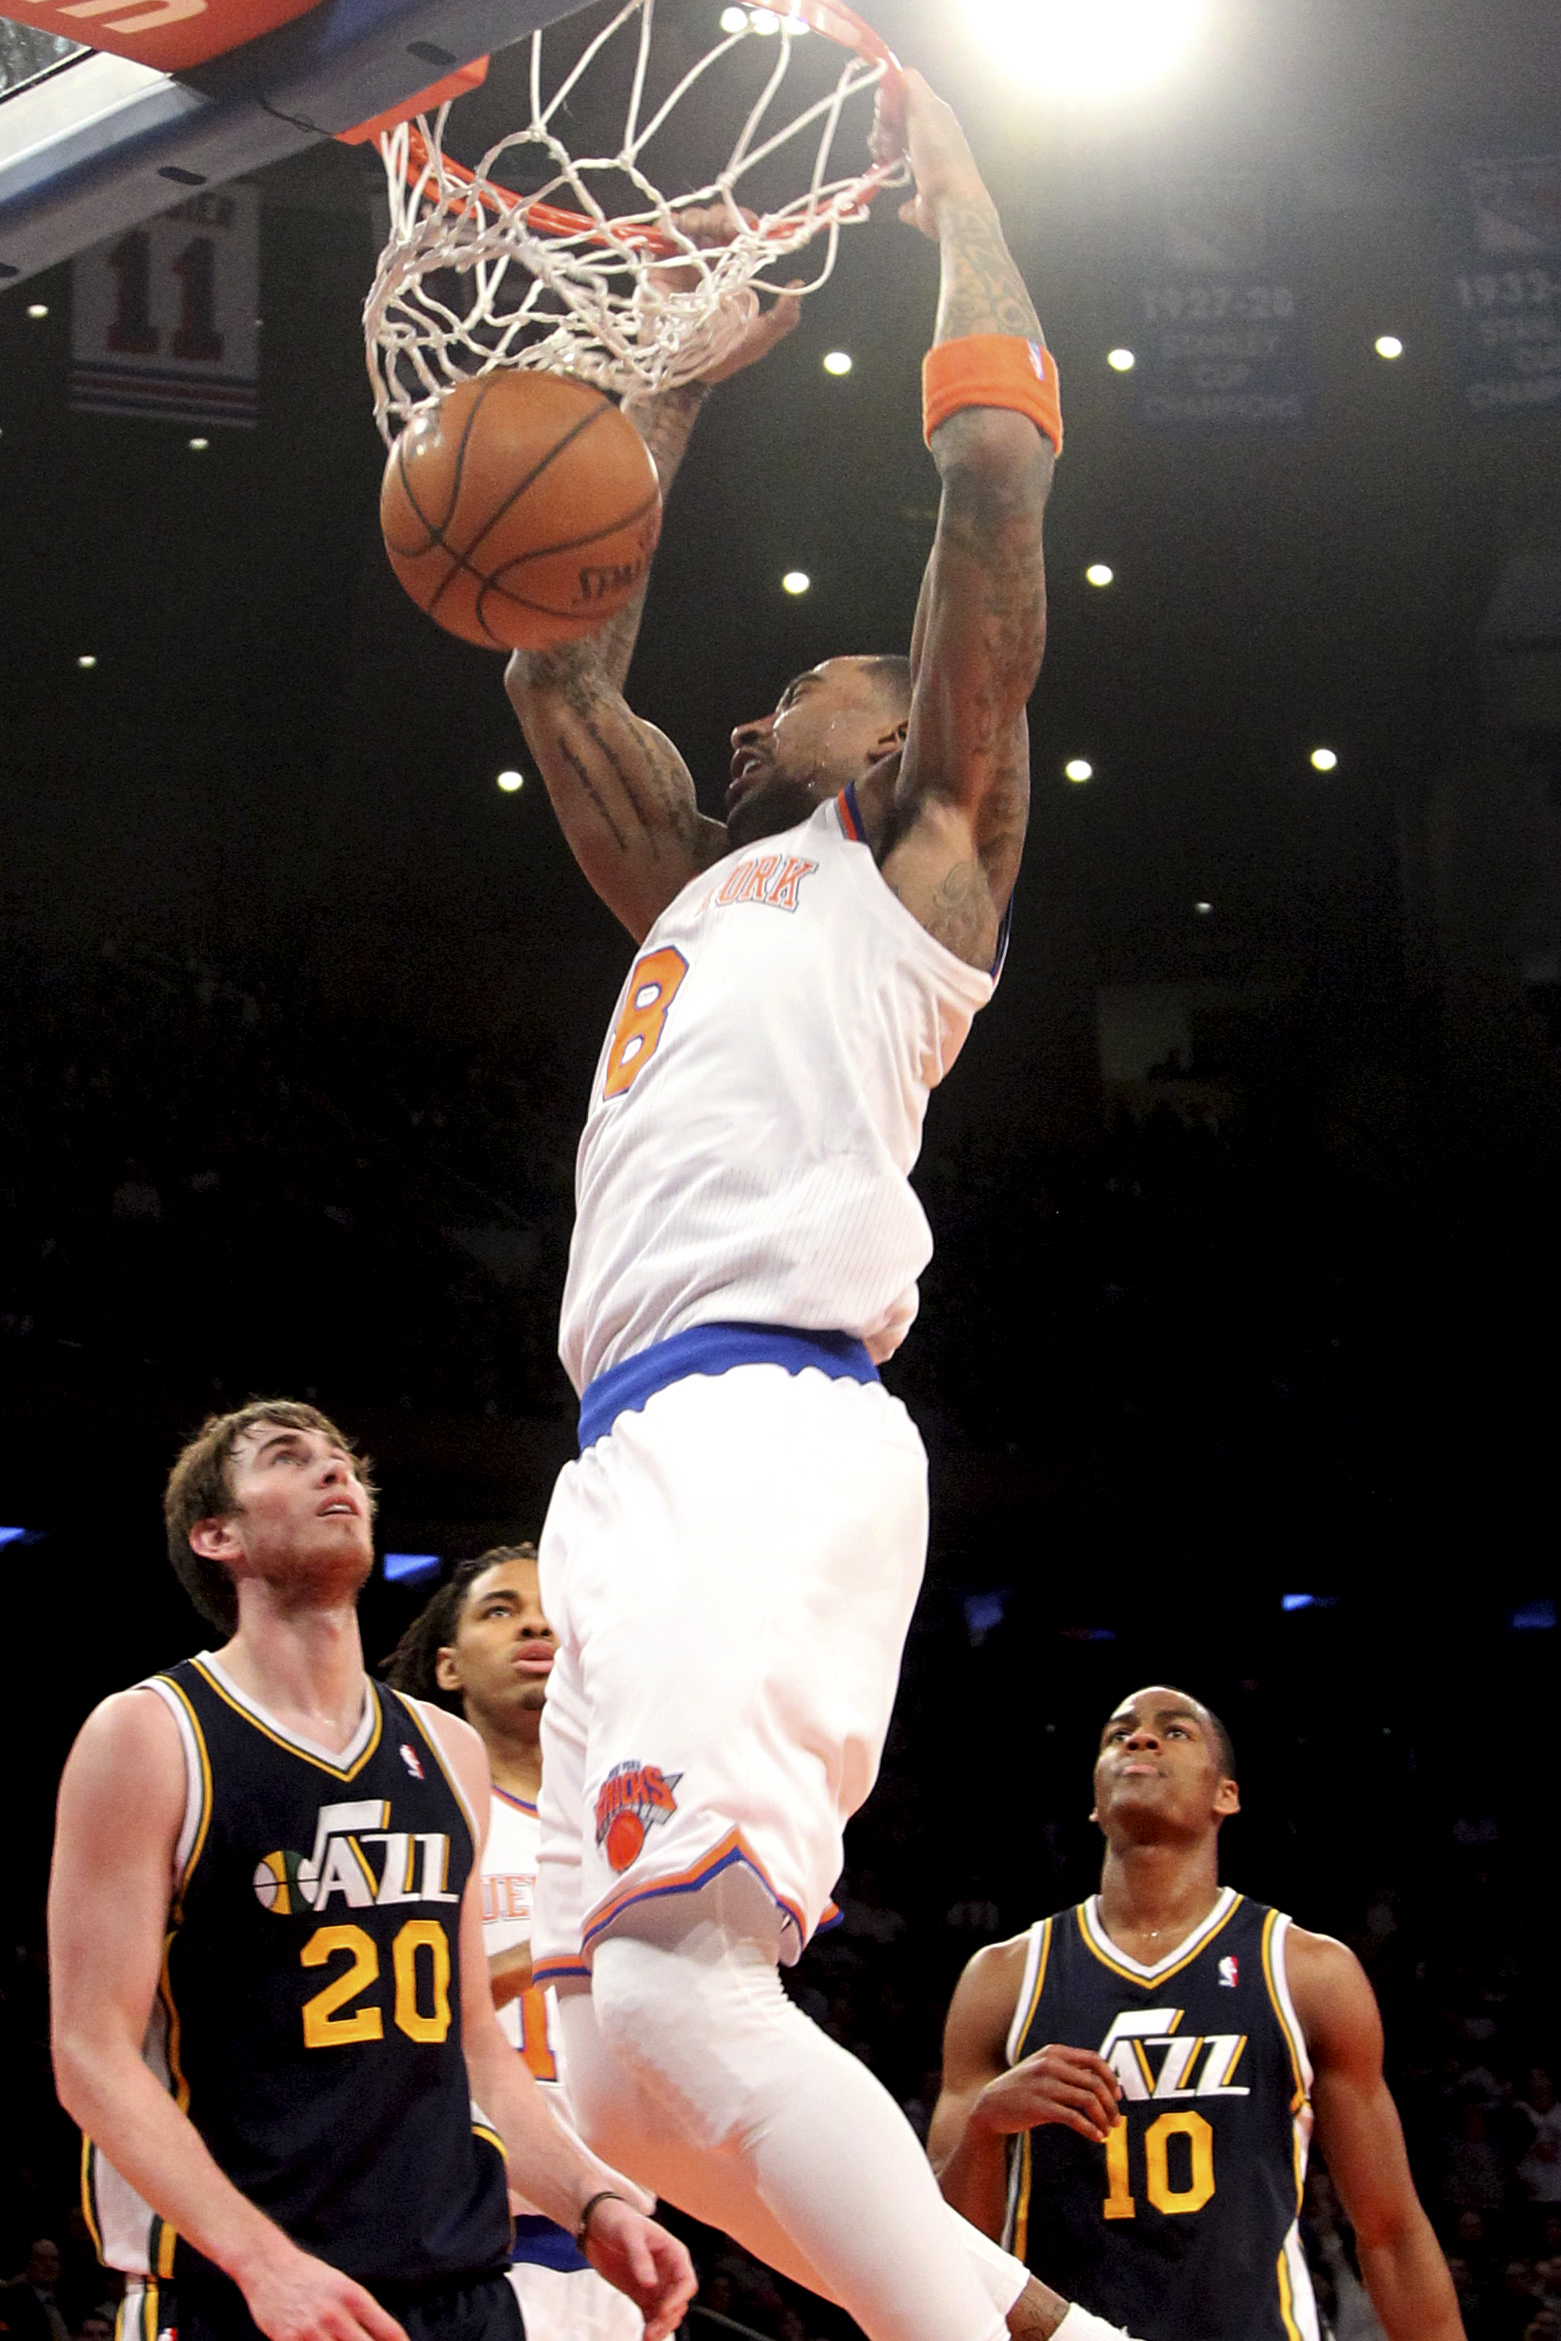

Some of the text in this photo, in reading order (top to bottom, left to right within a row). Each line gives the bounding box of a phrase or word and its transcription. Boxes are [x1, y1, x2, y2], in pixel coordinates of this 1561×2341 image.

[106, 229, 224, 361] 11
[693, 852, 820, 914] ORK
[602, 944, 690, 1104] 8
[256, 1799, 459, 1914] JAZZ
[300, 1919, 452, 2048] 20
[1101, 2110, 1216, 2220] 10
